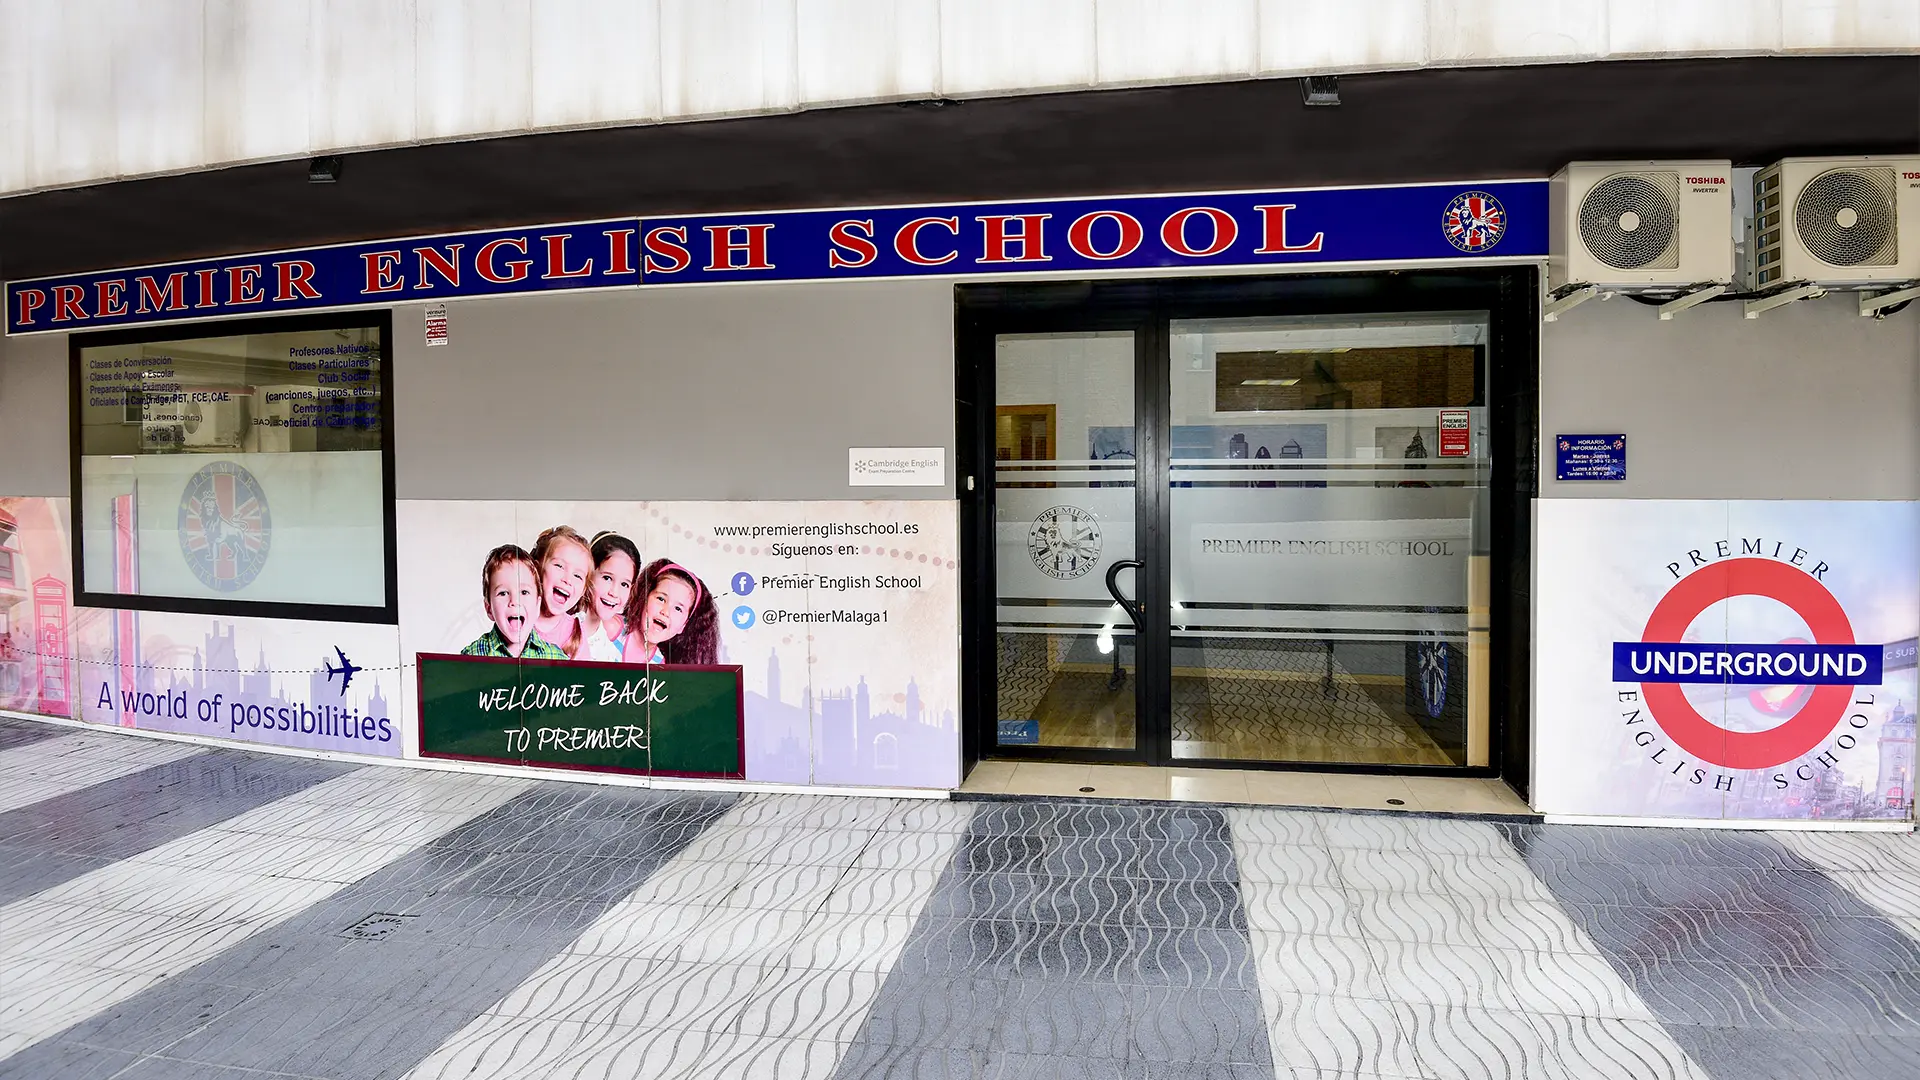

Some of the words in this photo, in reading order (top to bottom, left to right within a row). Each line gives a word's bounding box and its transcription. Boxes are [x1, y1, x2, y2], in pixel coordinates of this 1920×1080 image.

[1686, 177, 1725, 185] TOSHIBA
[1454, 193, 1495, 205] PREMIER
[1444, 222, 1473, 251] ENGLISH
[1481, 221, 1505, 250] SCHOOL
[16, 259, 322, 326] PREMIER
[360, 223, 775, 295] ENGLISH
[829, 204, 1324, 269] SCHOOL
[290, 347, 334, 357] Profesores
[337, 344, 370, 353] Nativos
[90, 360, 112, 369] Clases
[114, 359, 122, 368] de
[123, 356, 172, 367] Conversación
[289, 361, 316, 371] Clases
[319, 359, 370, 369] Particulares
[90, 373, 112, 382] Clases
[114, 372, 122, 380] de
[124, 371, 146, 382] Apoyo
[148, 369, 175, 379] Escolar
[318, 373, 338, 383] Club
[341, 371, 370, 382] Social
[132, 384, 140, 392] de
[90, 397, 119, 406] Oficiales
[120, 396, 129, 406] de
[265, 391, 316, 403] (canciones,
[293, 404, 322, 413] Centro
[324, 401, 375, 414] preparador
[284, 417, 310, 428] oficial
[312, 417, 324, 427] de
[325, 416, 376, 428] Cambridge
[868, 460, 909, 468] Cambridge
[911, 460, 939, 468] English
[1039, 507, 1090, 522] PREMIER
[714, 522, 919, 539] www.premierenglishschool.es
[772, 544, 833, 559] Síguenos
[838, 545, 859, 556] en:
[1202, 539, 1281, 554] PREMIER
[1289, 539, 1370, 555] ENGLISH
[1376, 541, 1453, 556] SCHOOL
[1029, 544, 1064, 578] ENGLISH
[1069, 549, 1100, 577] SCHOOL
[1667, 538, 1829, 581] PREMIER
[762, 576, 815, 589] Premier
[820, 575, 871, 591] English
[875, 575, 921, 589] School
[762, 610, 888, 626] @PremierMalaga1
[1630, 651, 1867, 677] UNDERGROUND
[478, 683, 585, 712] WELCOME
[599, 677, 669, 707] BACK
[97, 681, 114, 711] A
[121, 689, 188, 719] world
[198, 693, 223, 723] of
[230, 701, 392, 742] possibilities
[504, 728, 531, 753] TO
[537, 725, 649, 752] PREMIER
[1618, 690, 1735, 791] ENGLISH
[1772, 692, 1875, 790] SCHOOL
